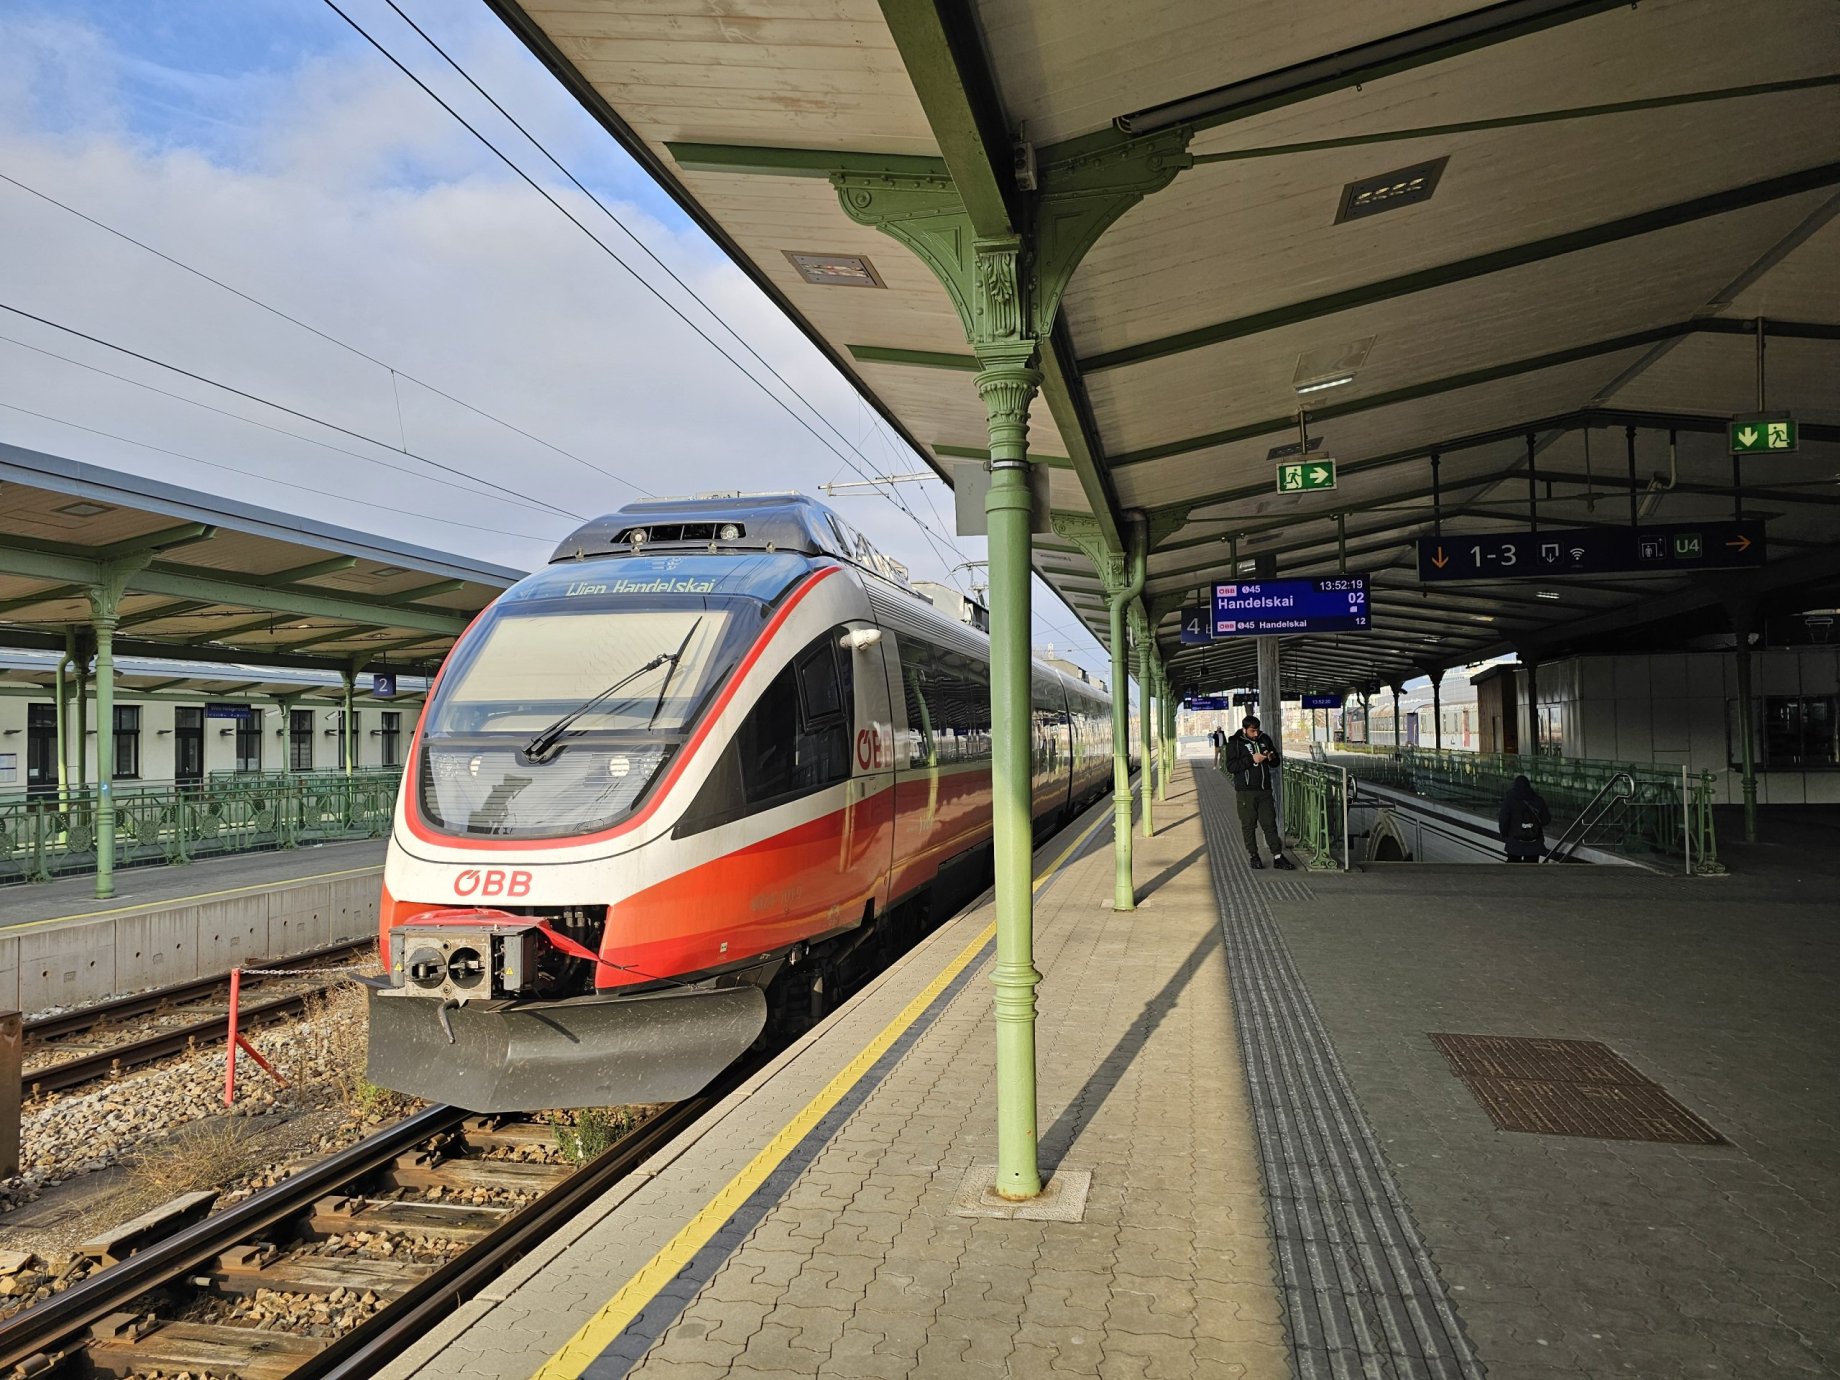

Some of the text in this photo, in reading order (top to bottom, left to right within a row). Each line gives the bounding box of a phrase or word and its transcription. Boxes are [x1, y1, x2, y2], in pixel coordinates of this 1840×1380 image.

[1675, 537, 1701, 554] U4
[1469, 544, 1517, 568] 1-3
[1319, 579, 1363, 591] 13:52:19
[1218, 595, 1294, 610] Handelskai
[1347, 592, 1365, 604] 02
[1186, 617, 1201, 635] 4
[1259, 619, 1307, 629] Handelskai
[1355, 617, 1366, 626] 12
[378, 677, 388, 692] 2
[453, 869, 533, 897] ÖBB
